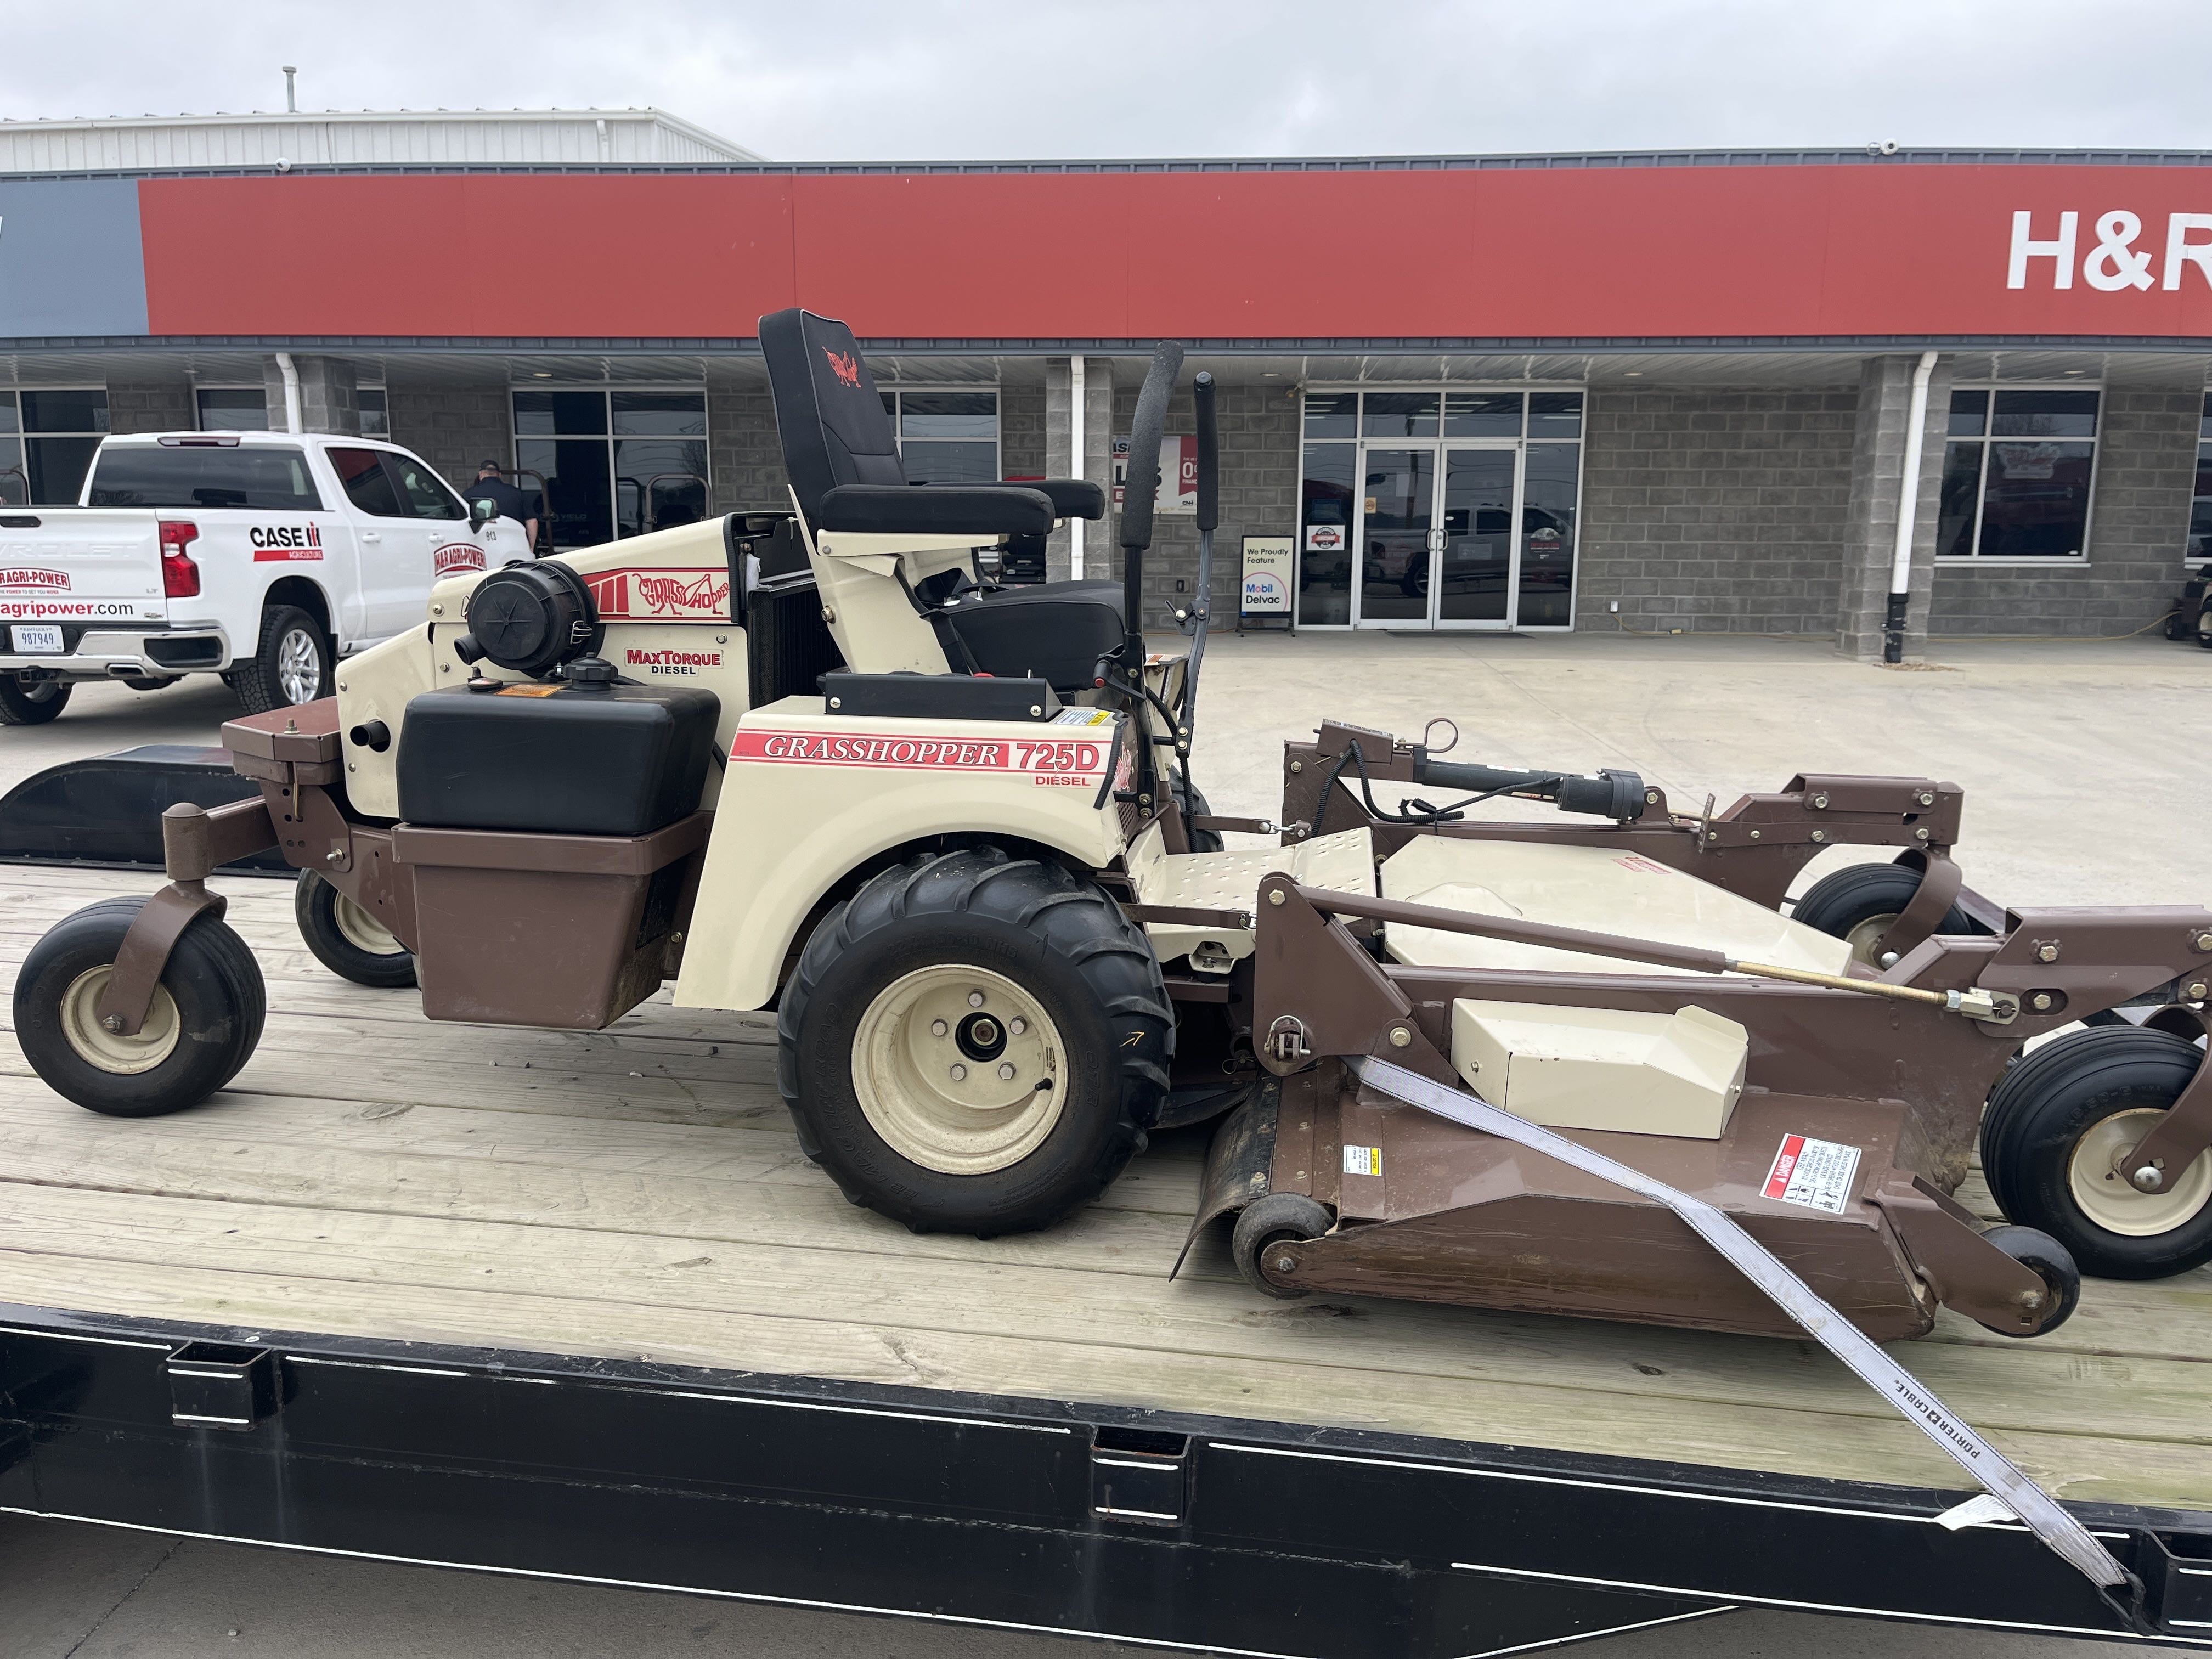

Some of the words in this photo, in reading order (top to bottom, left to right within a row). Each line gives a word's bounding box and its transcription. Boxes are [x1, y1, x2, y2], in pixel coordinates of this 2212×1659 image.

[2007, 210, 2212, 292] H&R
[250, 527, 304, 547] CASE
[486, 531, 497, 541] 913
[7, 571, 68, 586] AGRI-POWER
[1246, 584, 1273, 592] Mobil
[1246, 595, 1280, 603] Delvac
[22, 633, 54, 645] 987949
[652, 666, 696, 674] DIESEL
[764, 736, 1000, 765] GRASSHOPPER
[1017, 743, 1099, 770] 725D
[1035, 776, 1091, 786] DIESEL
[1775, 1155, 1796, 1177] DANGER
[1895, 1384, 1929, 1414] CABLE
[1939, 1420, 1981, 1459] PORTER
